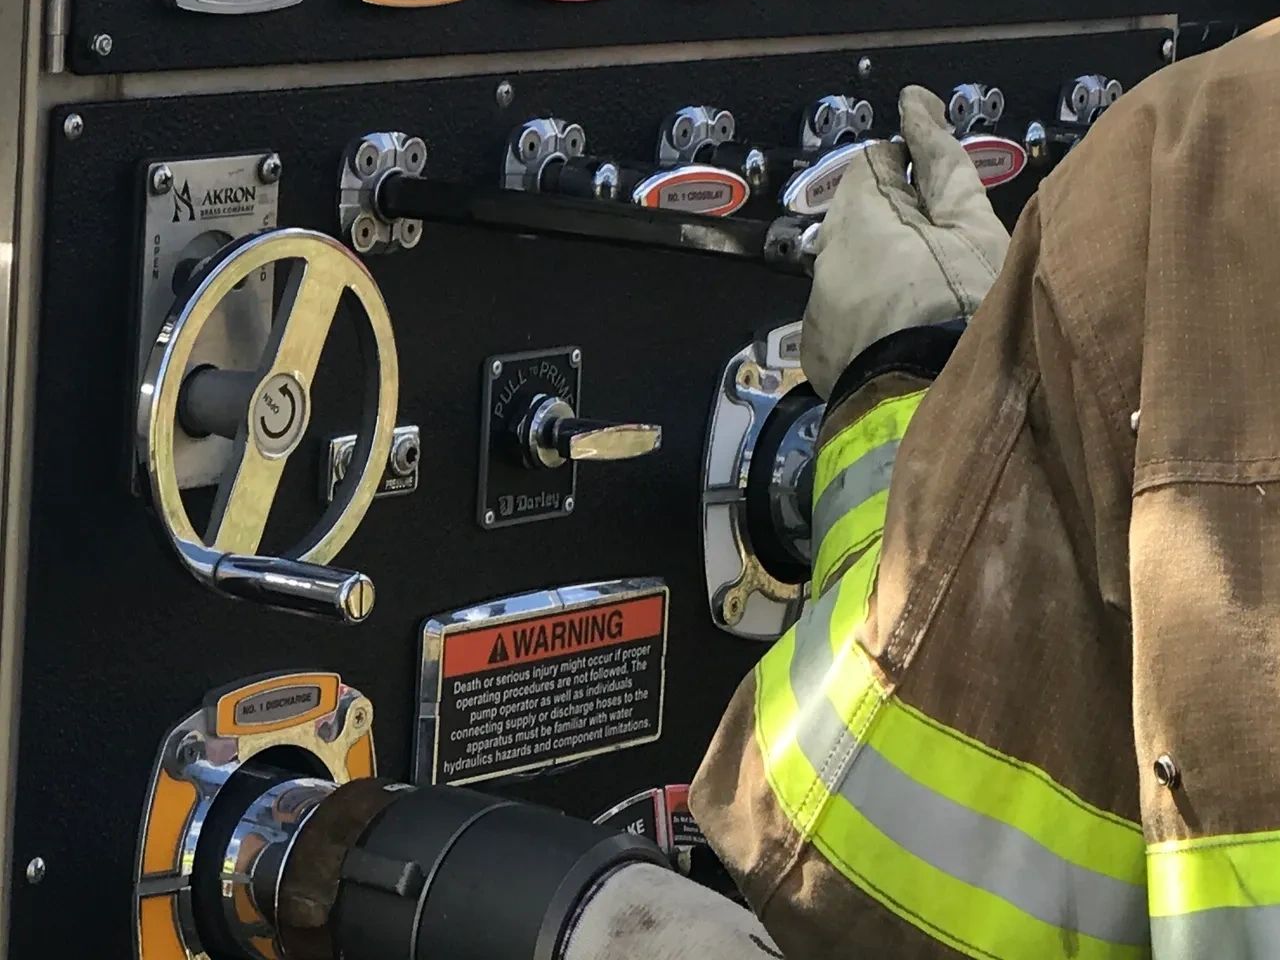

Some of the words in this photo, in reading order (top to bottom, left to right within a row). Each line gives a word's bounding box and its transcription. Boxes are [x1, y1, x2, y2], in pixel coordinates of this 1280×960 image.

[200, 208, 221, 217] BRASS
[222, 205, 255, 215] COMPANY
[202, 186, 256, 206] AKRON
[687, 190, 723, 201] CROSSLAY
[153, 234, 161, 280] OPEN
[495, 369, 528, 419] PULL
[539, 361, 575, 404] PRIME
[517, 491, 560, 512] Darley
[512, 609, 624, 659] WARNING
[453, 677, 482, 695] Death
[483, 679, 494, 689] or
[496, 669, 531, 686] serious
[532, 664, 559, 680] injury
[560, 656, 586, 674] might
[588, 652, 613, 667] occur
[614, 648, 622, 661] if
[622, 644, 651, 661] proper
[456, 690, 501, 711] operating
[503, 680, 555, 702] procedures
[557, 676, 571, 689] are
[573, 672, 588, 685] not
[590, 663, 629, 681] followed.
[631, 659, 647, 673] The
[242, 704, 256, 715] NO.
[265, 692, 313, 711] DISCHARGE
[450, 719, 504, 741] connecting
[505, 712, 537, 731] supply
[538, 711, 548, 722] or
[550, 701, 594, 720] discharge
[596, 695, 622, 710] hoses
[624, 692, 634, 703] to
[634, 688, 649, 701] the
[470, 706, 498, 725] pump
[499, 698, 539, 717] operator
[540, 696, 551, 708] as
[553, 689, 571, 704] well
[572, 688, 584, 700] as
[585, 677, 633, 697] individuals
[443, 753, 494, 775] hydraulics
[495, 743, 532, 762] hazards
[533, 738, 551, 754] and
[553, 727, 603, 748] component
[604, 718, 651, 738] limitations.
[466, 733, 513, 754] apparatus
[515, 726, 539, 741] must
[540, 724, 552, 737] be
[554, 717, 587, 734] familiar
[588, 712, 608, 726] with
[609, 707, 634, 721] water
